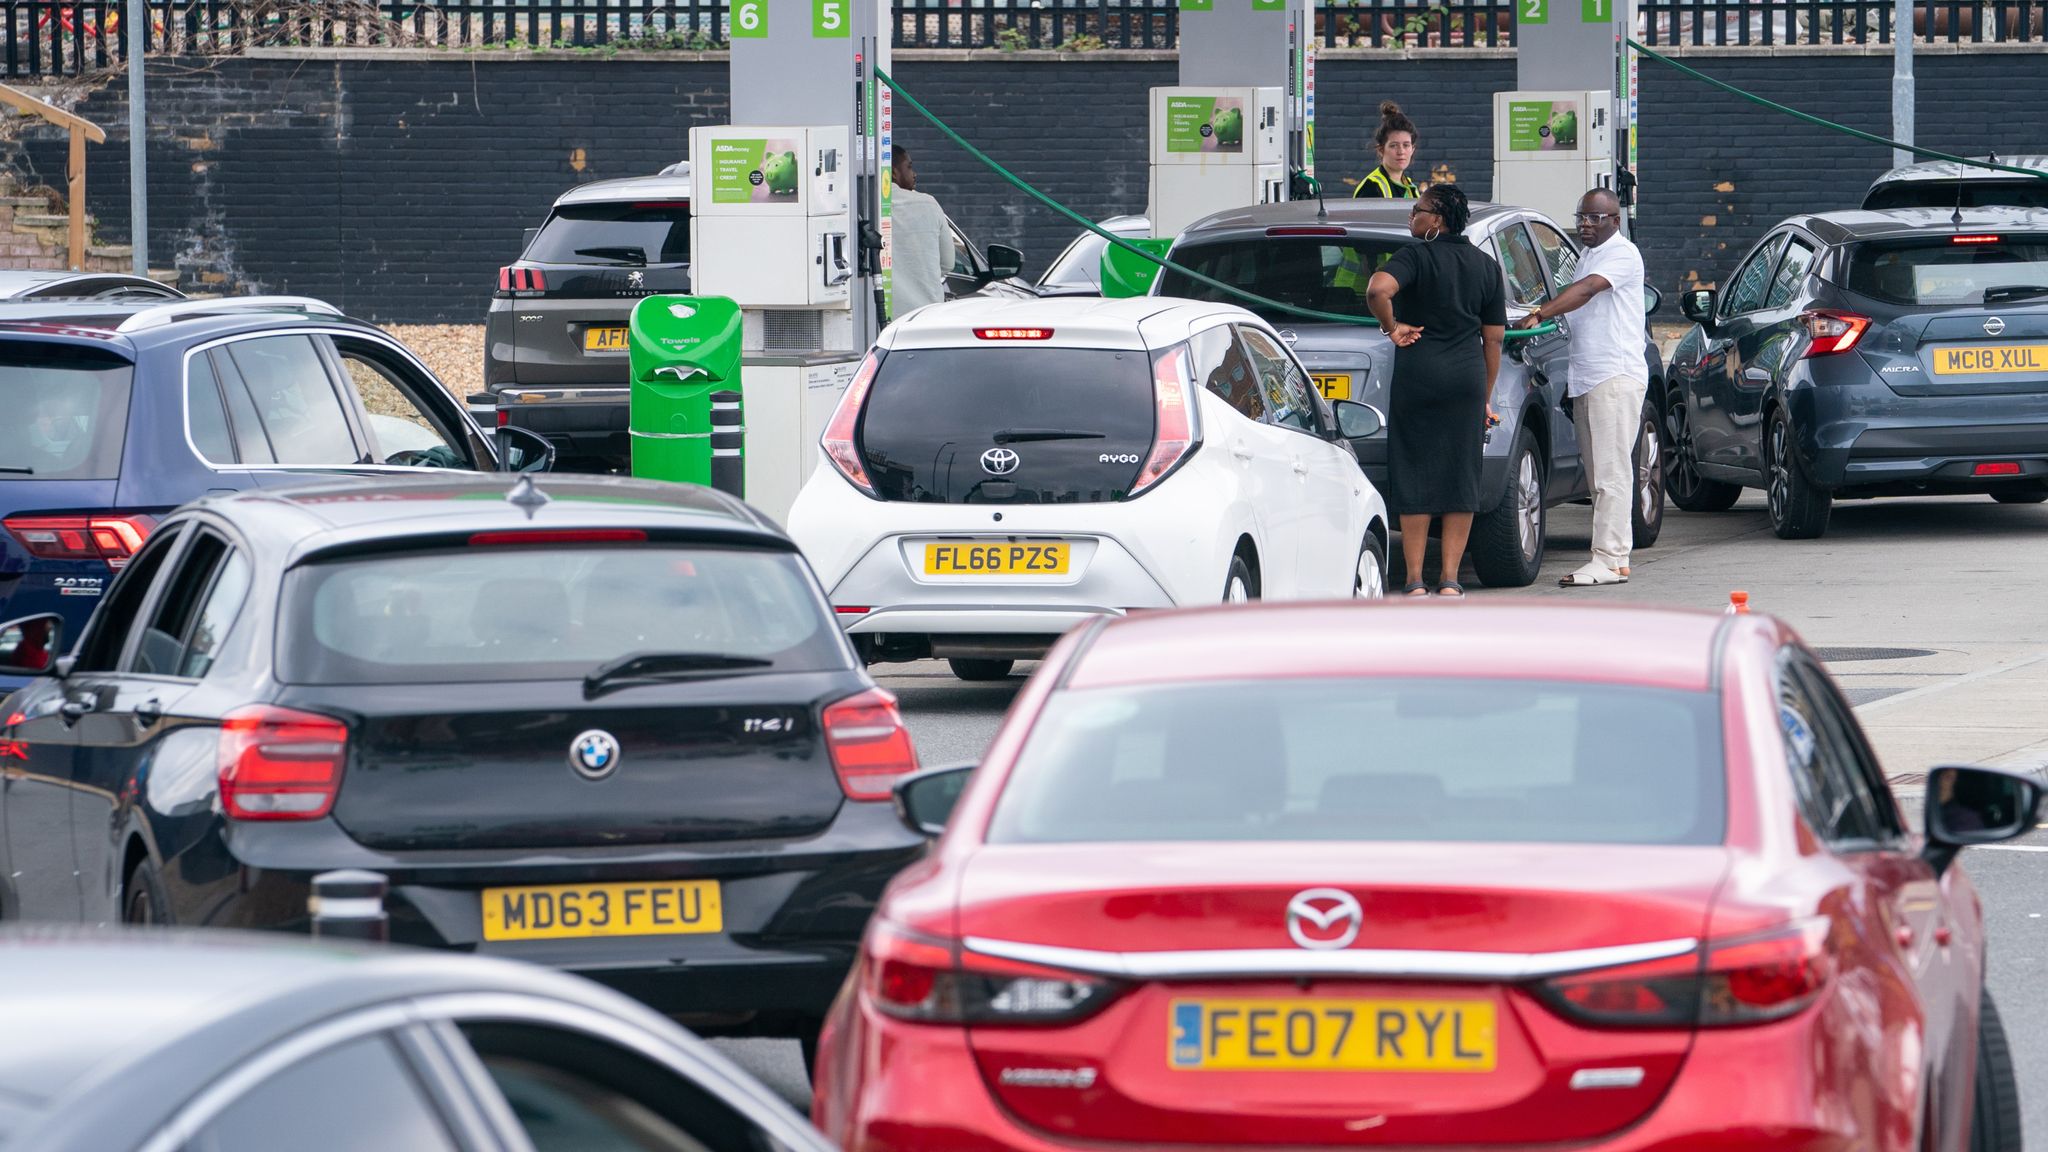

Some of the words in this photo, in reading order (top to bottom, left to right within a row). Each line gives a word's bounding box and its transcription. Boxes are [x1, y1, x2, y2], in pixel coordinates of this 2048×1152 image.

[739, 3, 759, 30] 6
[821, 3, 841, 30] 5
[1525, 0, 1541, 18] 2
[1592, 0, 1602, 17] 1
[597, 328, 630, 346] AF1
[660, 336, 701, 345] Towels
[1947, 350, 1994, 370] MC18
[2000, 348, 2041, 368] XUL
[1098, 453, 1139, 464] AYGO
[935, 547, 1001, 570] FL66
[1009, 547, 1059, 570] PZS
[503, 891, 611, 931] MD63
[624, 887, 702, 926] FEU
[1208, 1009, 1357, 1058] FE07
[1377, 1009, 1484, 1060] RYL
